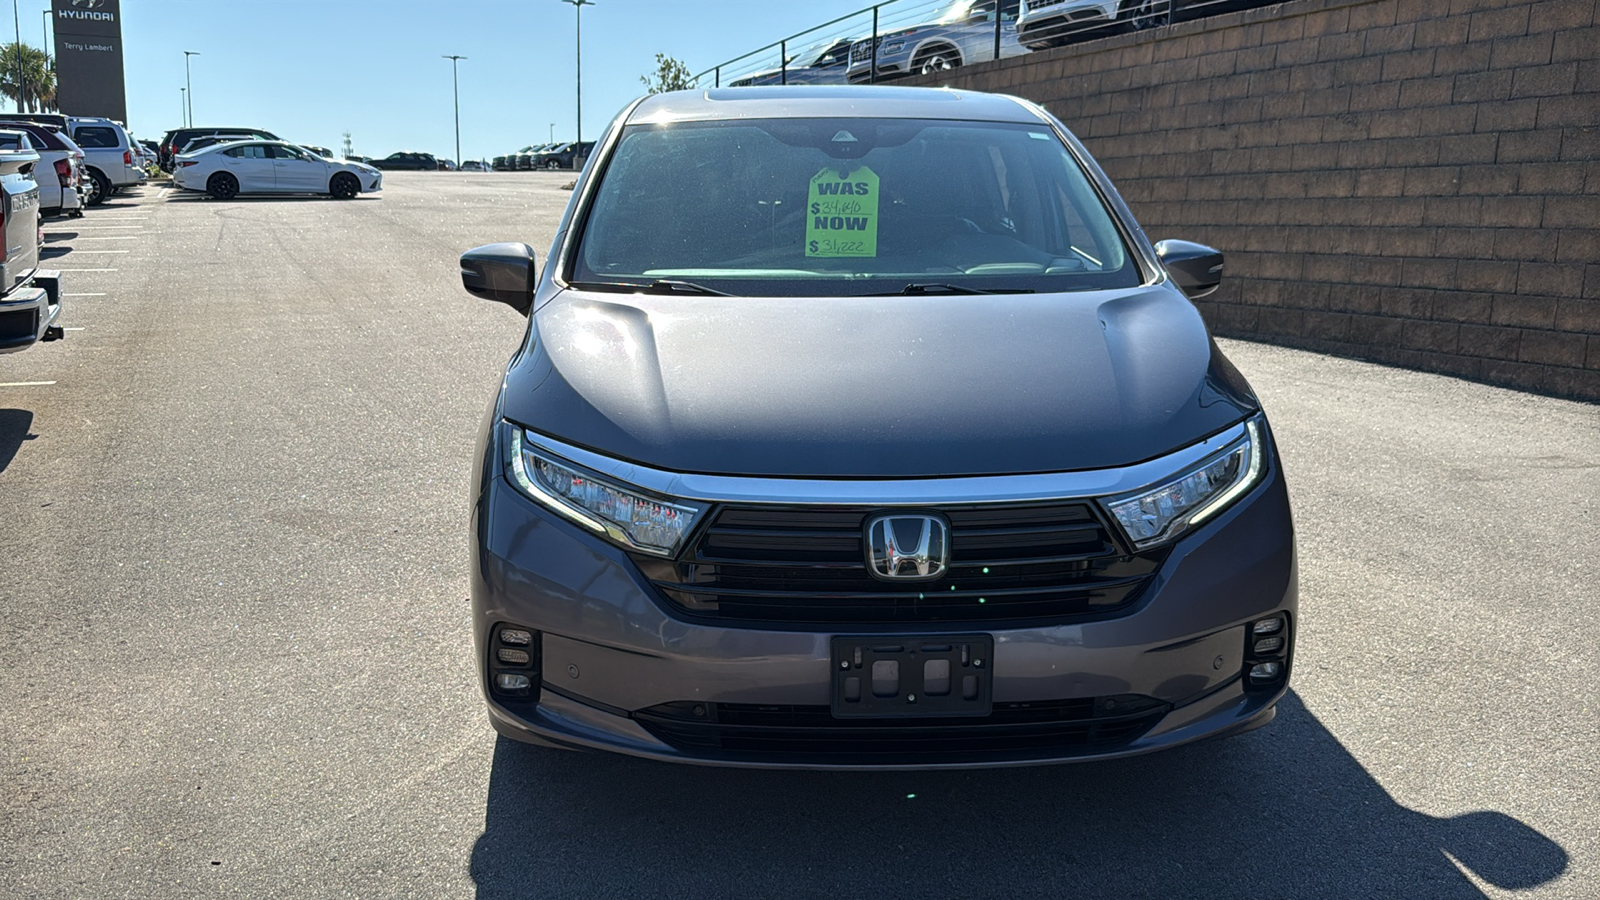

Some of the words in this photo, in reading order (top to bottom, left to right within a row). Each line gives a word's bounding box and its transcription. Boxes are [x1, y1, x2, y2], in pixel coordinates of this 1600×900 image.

[58, 9, 114, 22] HYUNDAI
[64, 42, 83, 52] Terry
[84, 43, 114, 52] Lambert
[817, 182, 869, 196] WAS
[813, 216, 869, 231] NOW
